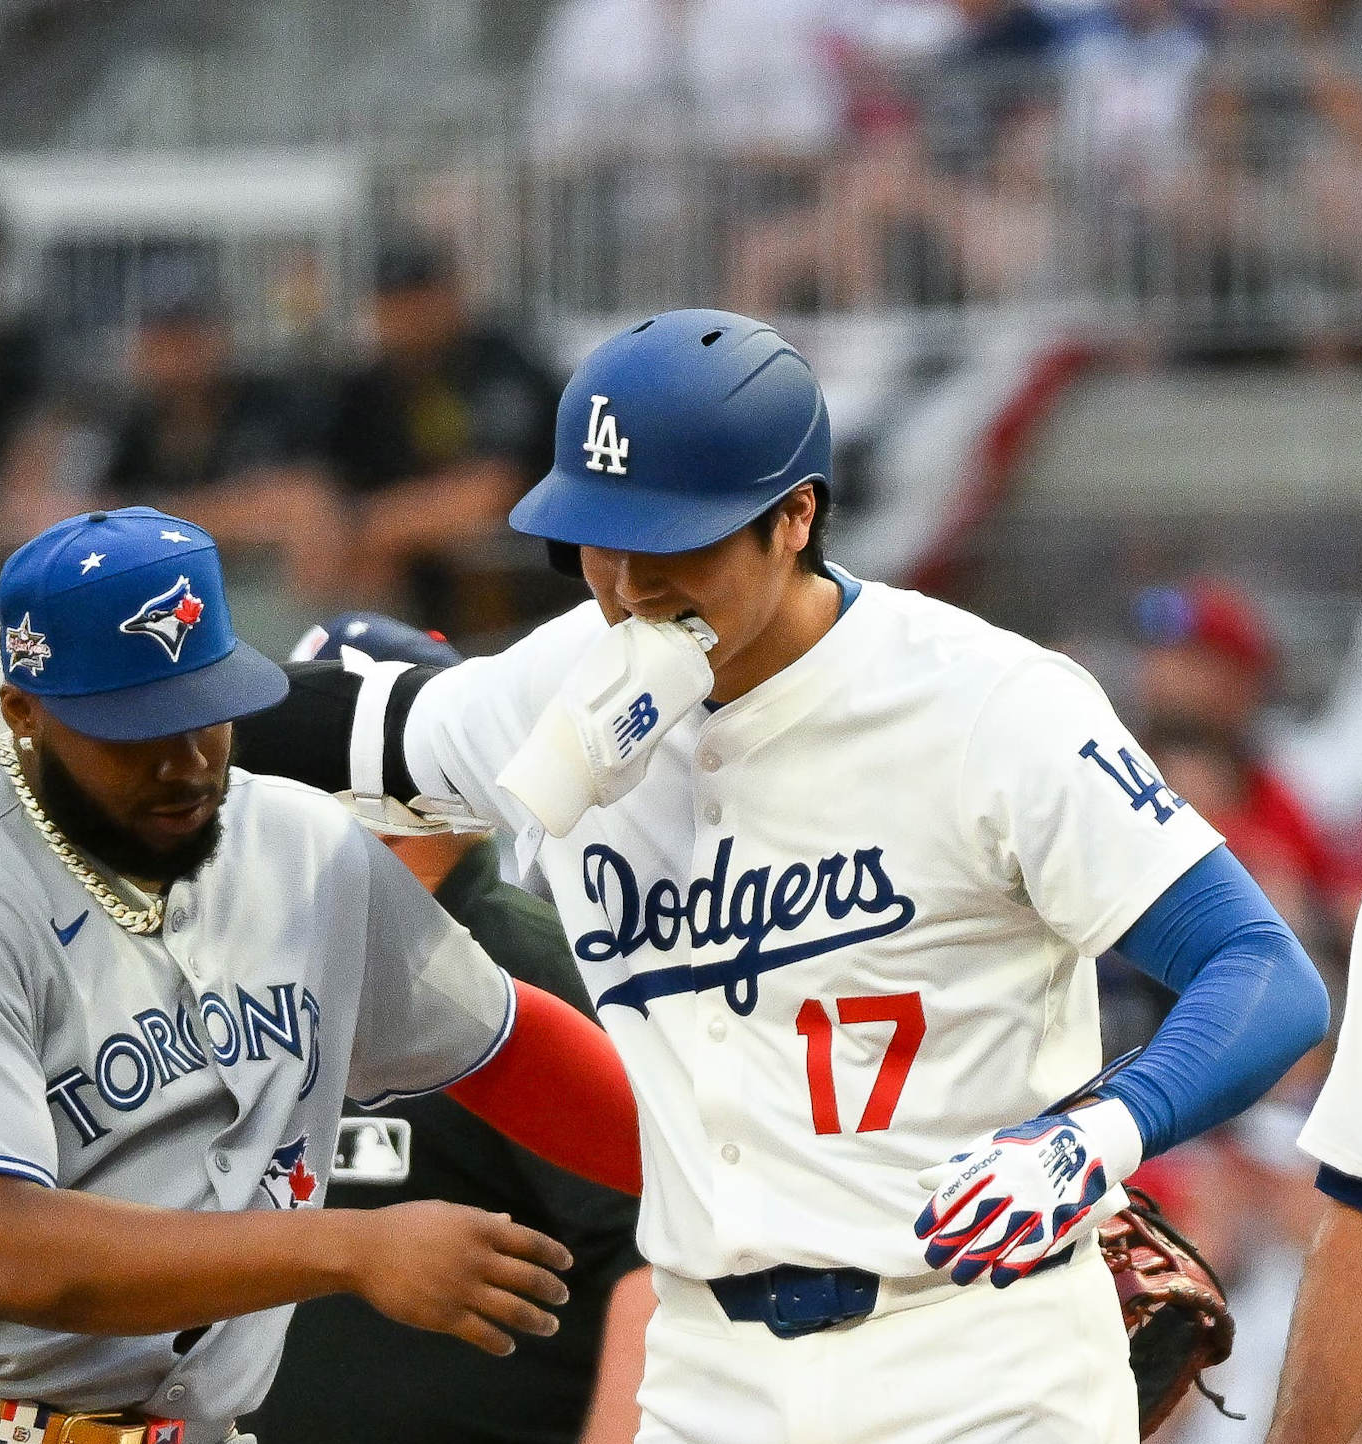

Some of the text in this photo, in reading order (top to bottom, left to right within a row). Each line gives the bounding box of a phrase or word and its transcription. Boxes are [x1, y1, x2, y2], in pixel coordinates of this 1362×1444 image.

[583, 394, 629, 475] LA
[575, 836, 916, 1019] Dodgers
[45, 982, 321, 1148] TORON
[795, 991, 927, 1135] 17
[941, 1148, 1003, 1201] new balance
